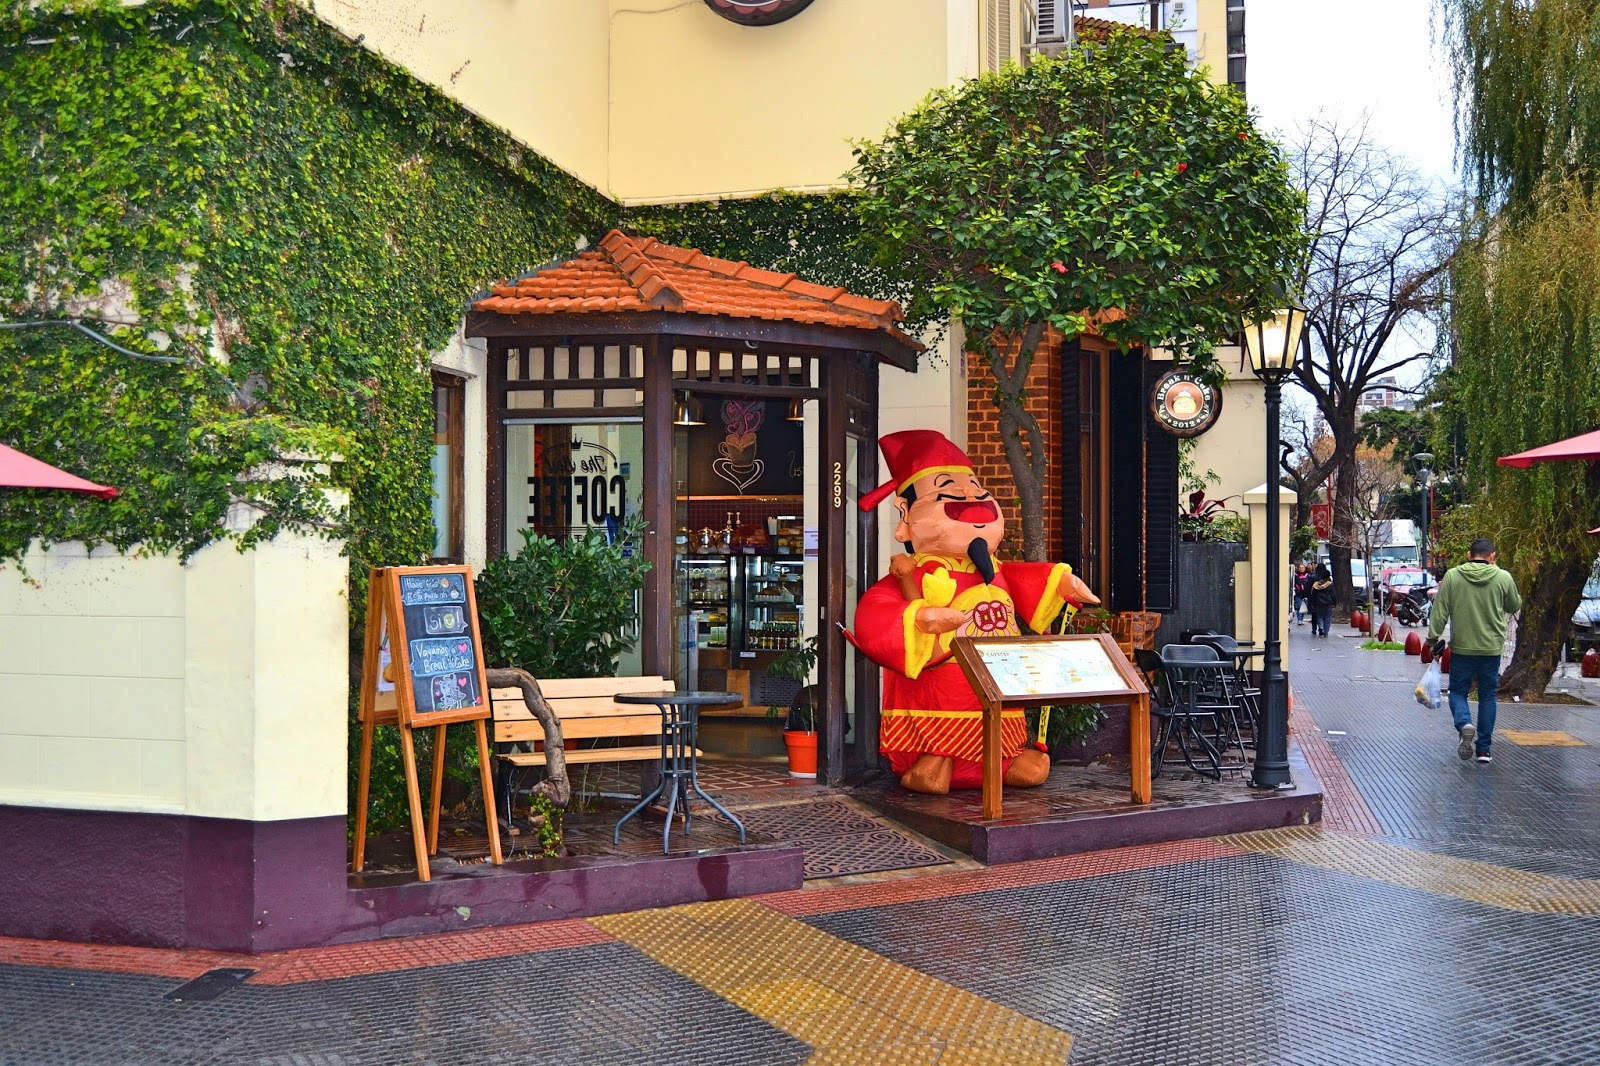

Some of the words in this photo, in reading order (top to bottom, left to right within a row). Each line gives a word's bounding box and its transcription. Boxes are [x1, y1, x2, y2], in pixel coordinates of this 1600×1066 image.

[1157, 375, 1181, 400] Break
[1194, 376, 1211, 400] Cake
[833, 462, 842, 508] 2299
[415, 643, 449, 661] Vayamos
[423, 658, 448, 673] Break
[454, 656, 470, 669] Cake
